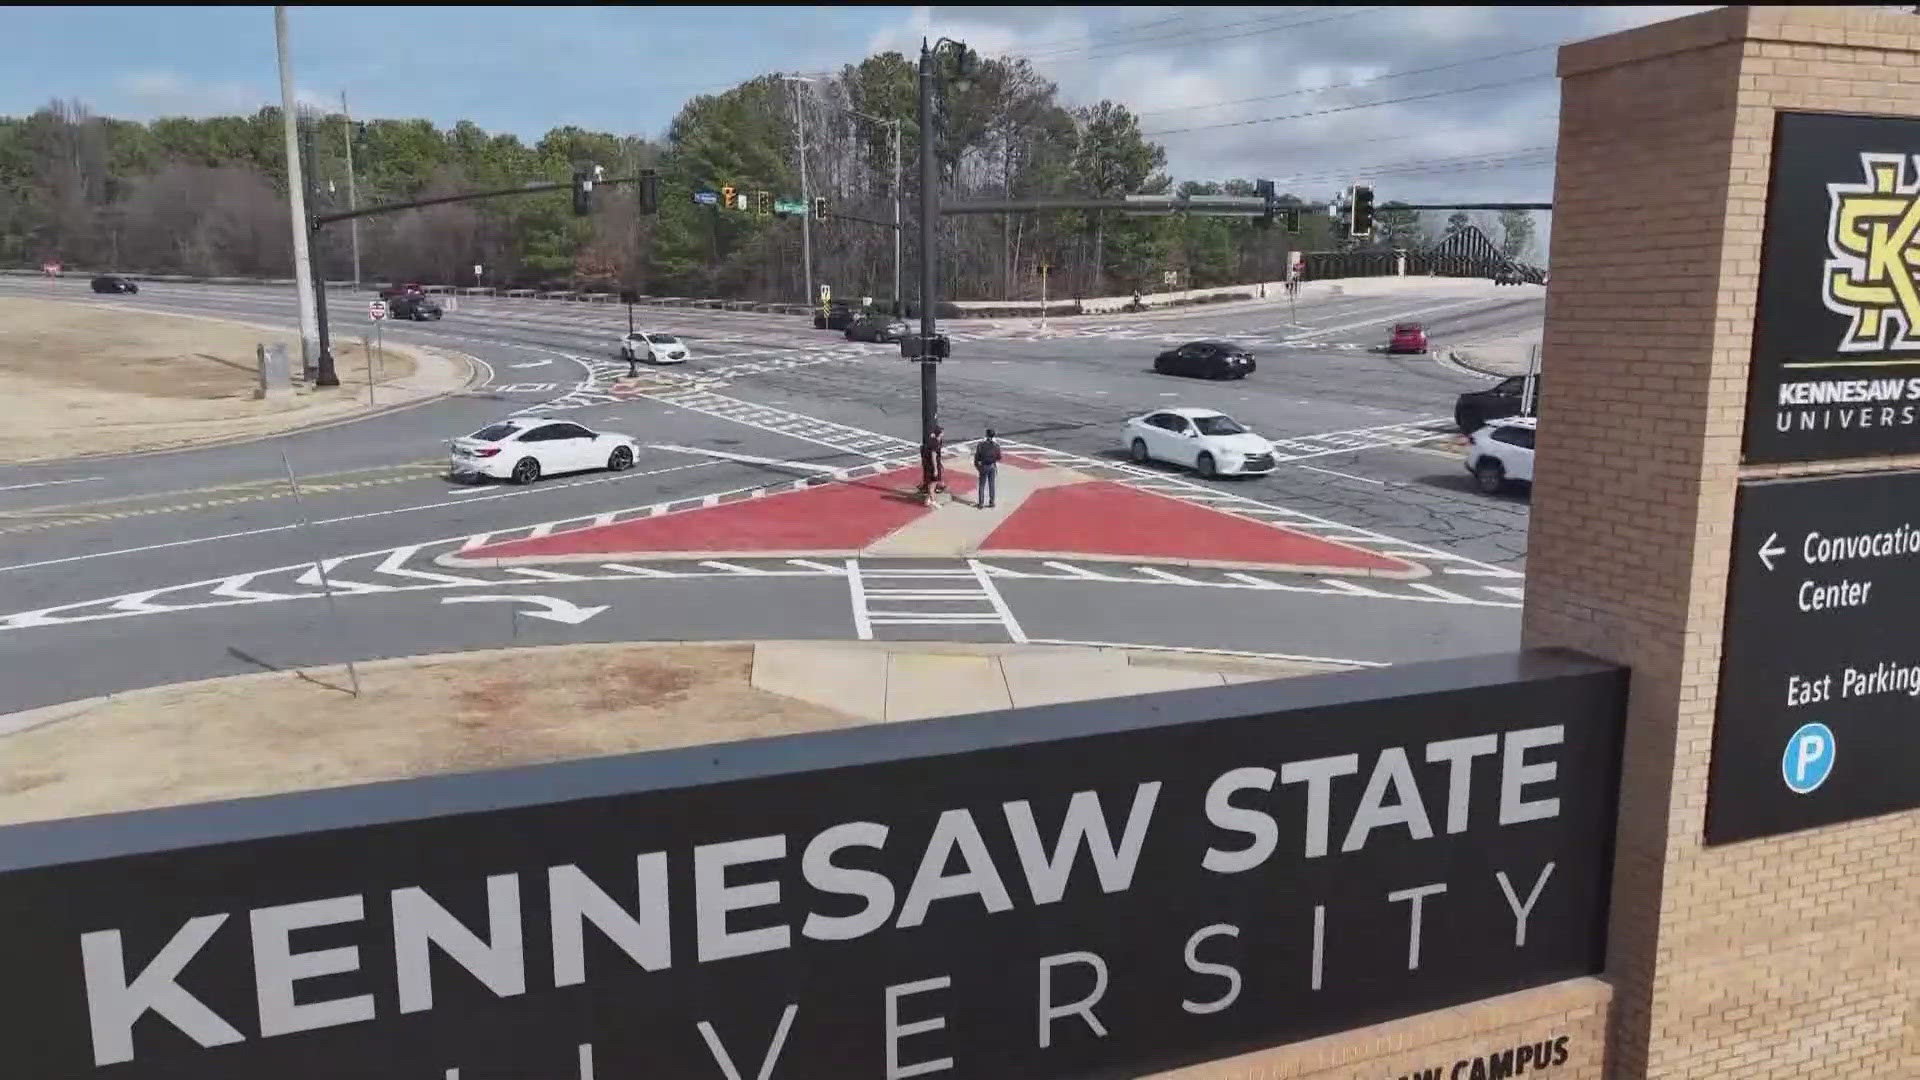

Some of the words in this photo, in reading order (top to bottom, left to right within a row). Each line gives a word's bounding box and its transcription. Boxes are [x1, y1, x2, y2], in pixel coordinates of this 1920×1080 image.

[1778, 378, 1904, 406] KENNESAW
[1803, 523, 1920, 564] Convocatio
[1798, 578, 1872, 612] Center
[1787, 674, 1832, 706] East
[1842, 661, 1920, 699] Parking
[1797, 734, 1824, 781] P
[81, 781, 1161, 1067] KENNESAW
[1202, 724, 1565, 874] STATE
[446, 861, 1556, 1080] VERSITY
[1451, 1036, 1569, 1080] CAMPUS
